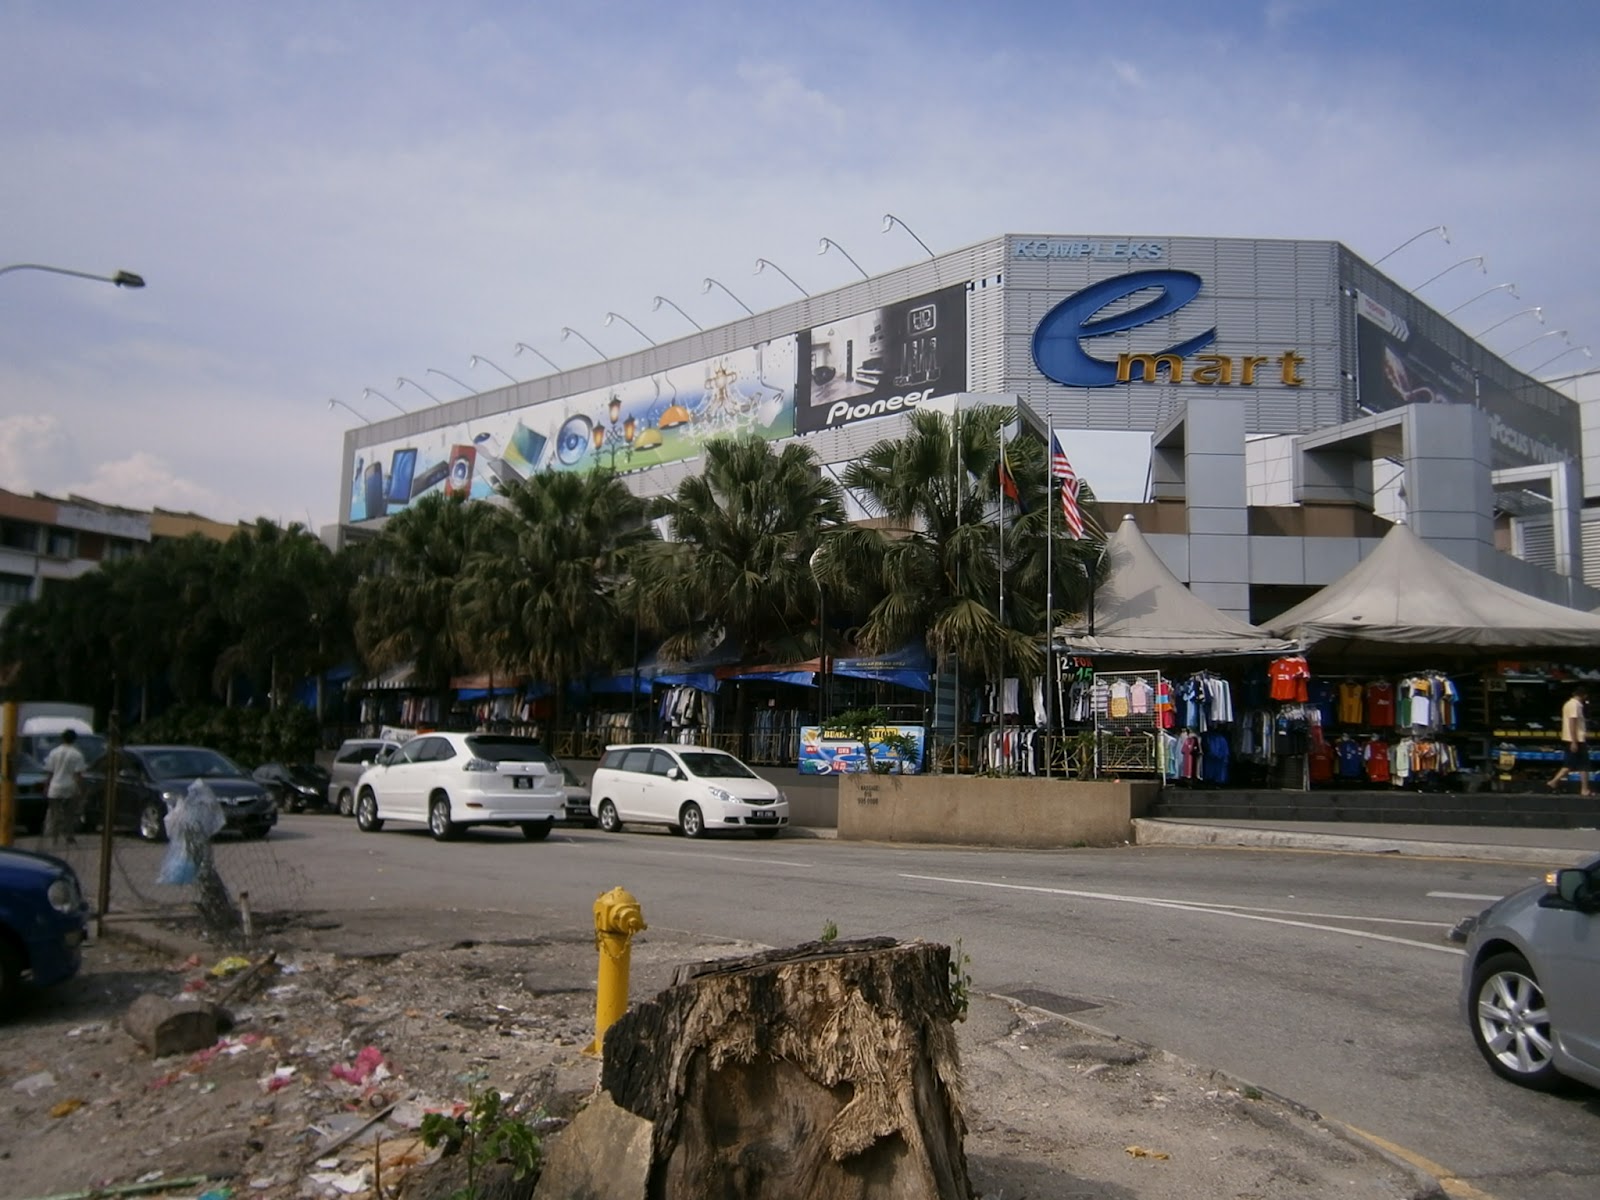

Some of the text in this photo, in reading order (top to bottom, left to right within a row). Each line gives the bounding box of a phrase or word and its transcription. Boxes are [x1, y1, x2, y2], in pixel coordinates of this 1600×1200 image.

[1013, 240, 1162, 260] KOMPLEKS
[1115, 351, 1304, 385] mart
[826, 388, 935, 425] Pioneer
[1076, 667, 1093, 682] 15
